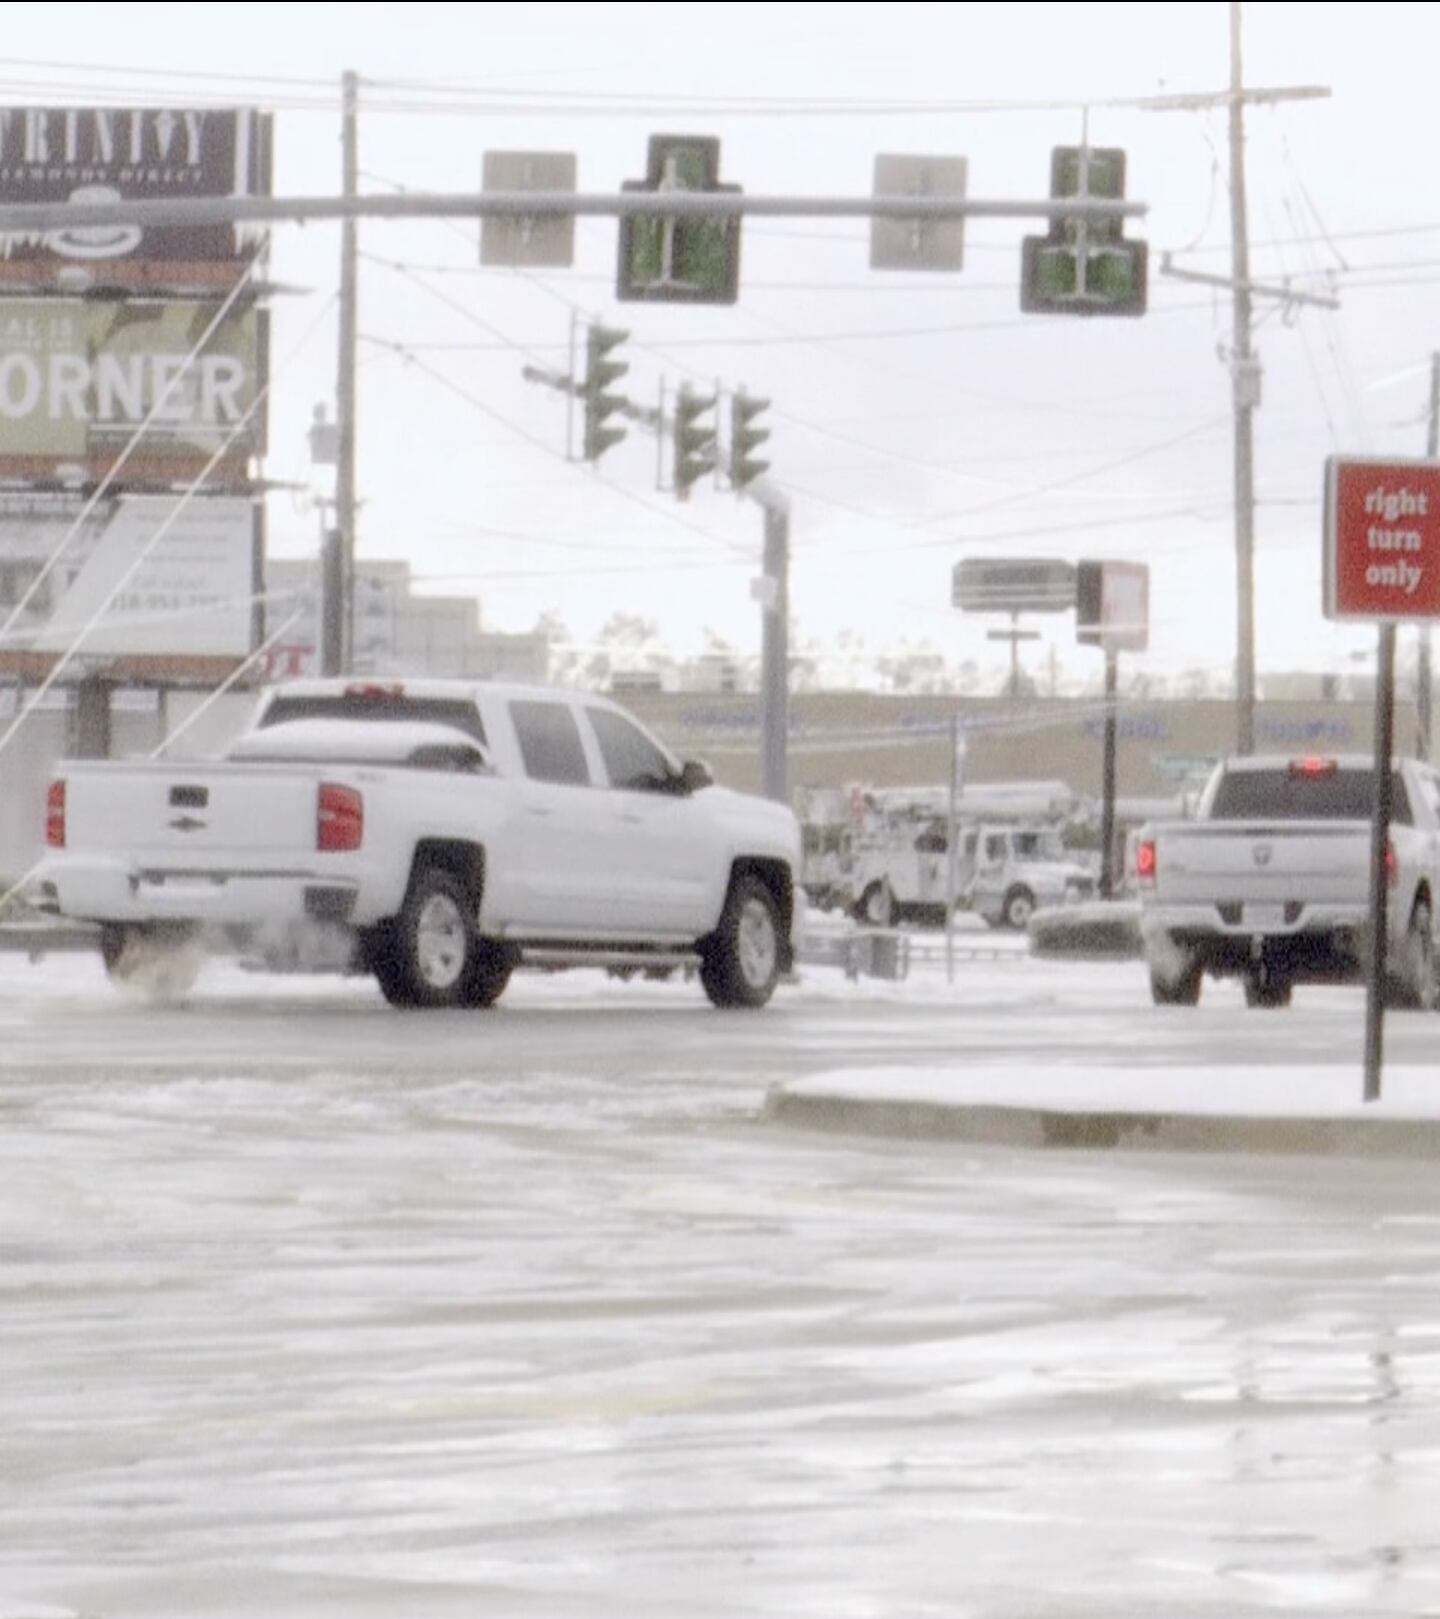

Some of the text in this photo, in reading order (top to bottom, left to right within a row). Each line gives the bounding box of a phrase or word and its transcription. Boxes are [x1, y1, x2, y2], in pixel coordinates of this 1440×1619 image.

[0, 352, 246, 421] ORNER
[1364, 486, 1428, 521] right
[1367, 526, 1422, 550] turn
[1365, 559, 1422, 594] only
